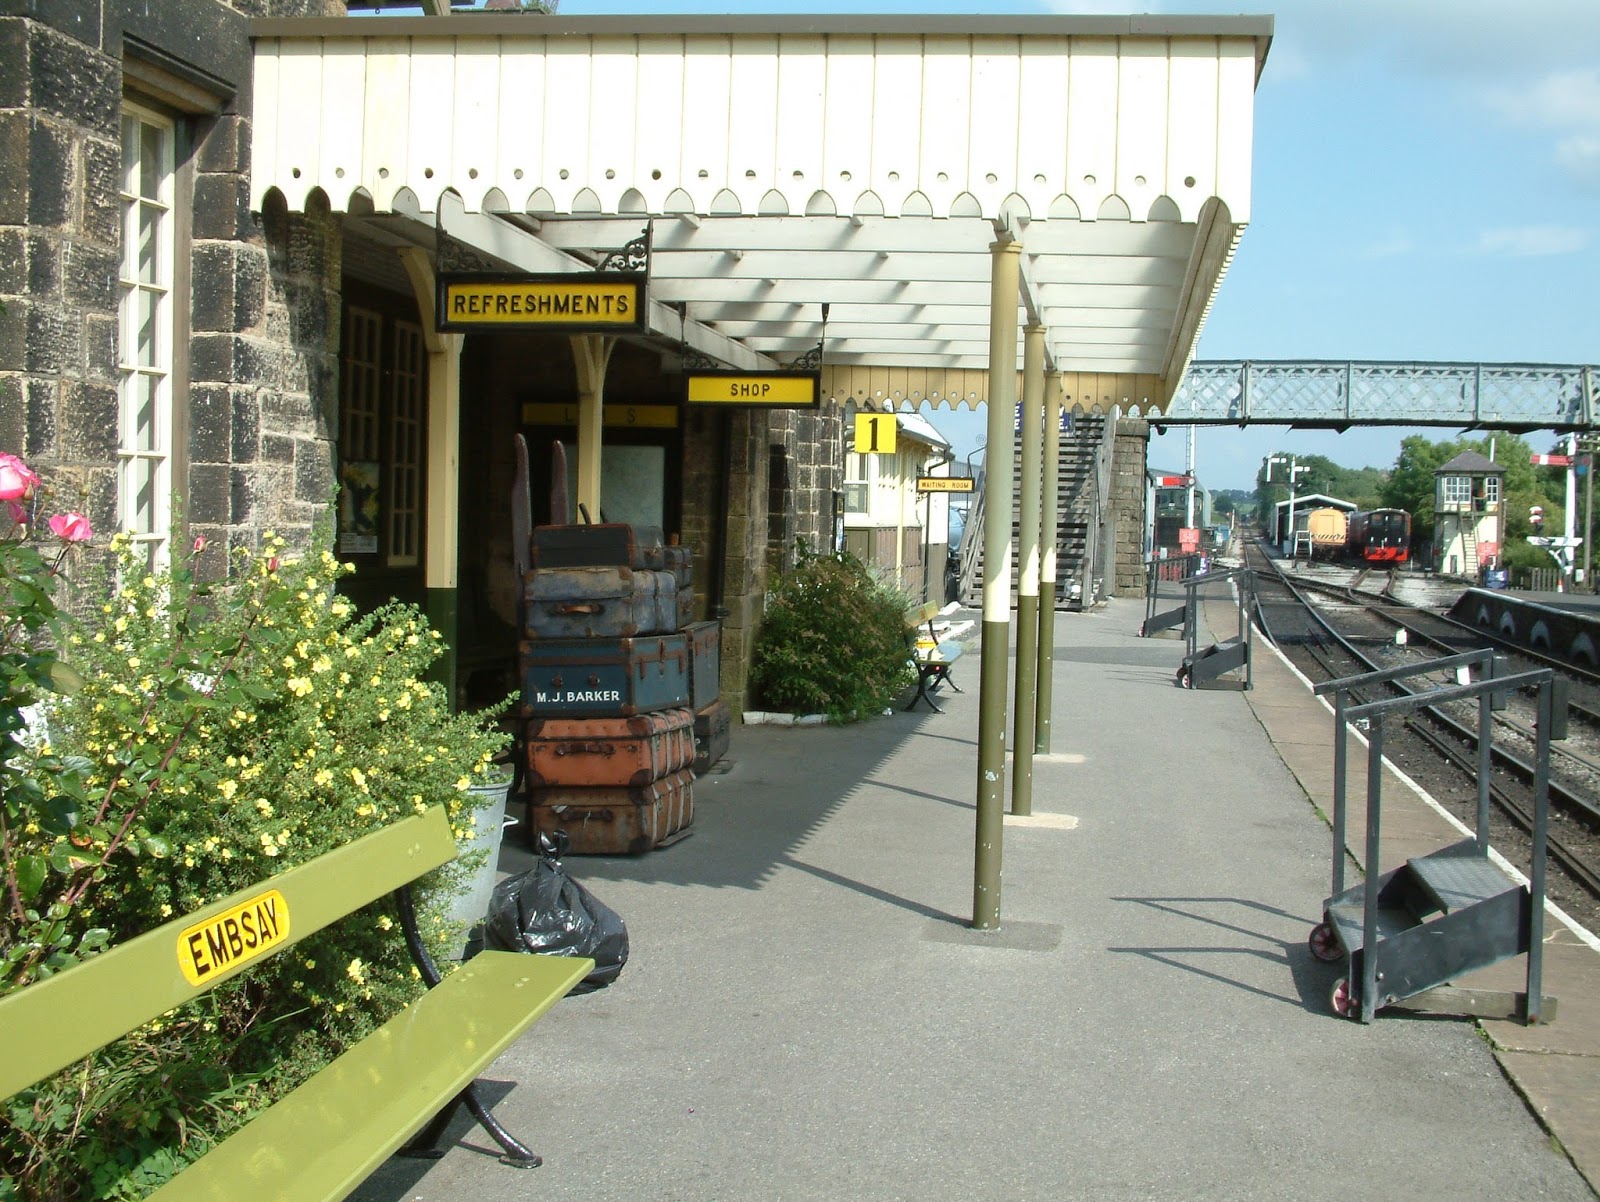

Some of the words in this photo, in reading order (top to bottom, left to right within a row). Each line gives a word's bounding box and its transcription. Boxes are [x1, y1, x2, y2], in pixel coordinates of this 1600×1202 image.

[453, 294, 630, 315] REFRESHMENTS
[730, 383, 771, 397] SHOP
[868, 417, 879, 452] 1
[921, 481, 946, 489] WAITING
[951, 481, 970, 489] ROOM
[566, 690, 620, 702] BARKER
[187, 897, 279, 977] EMBSAY
